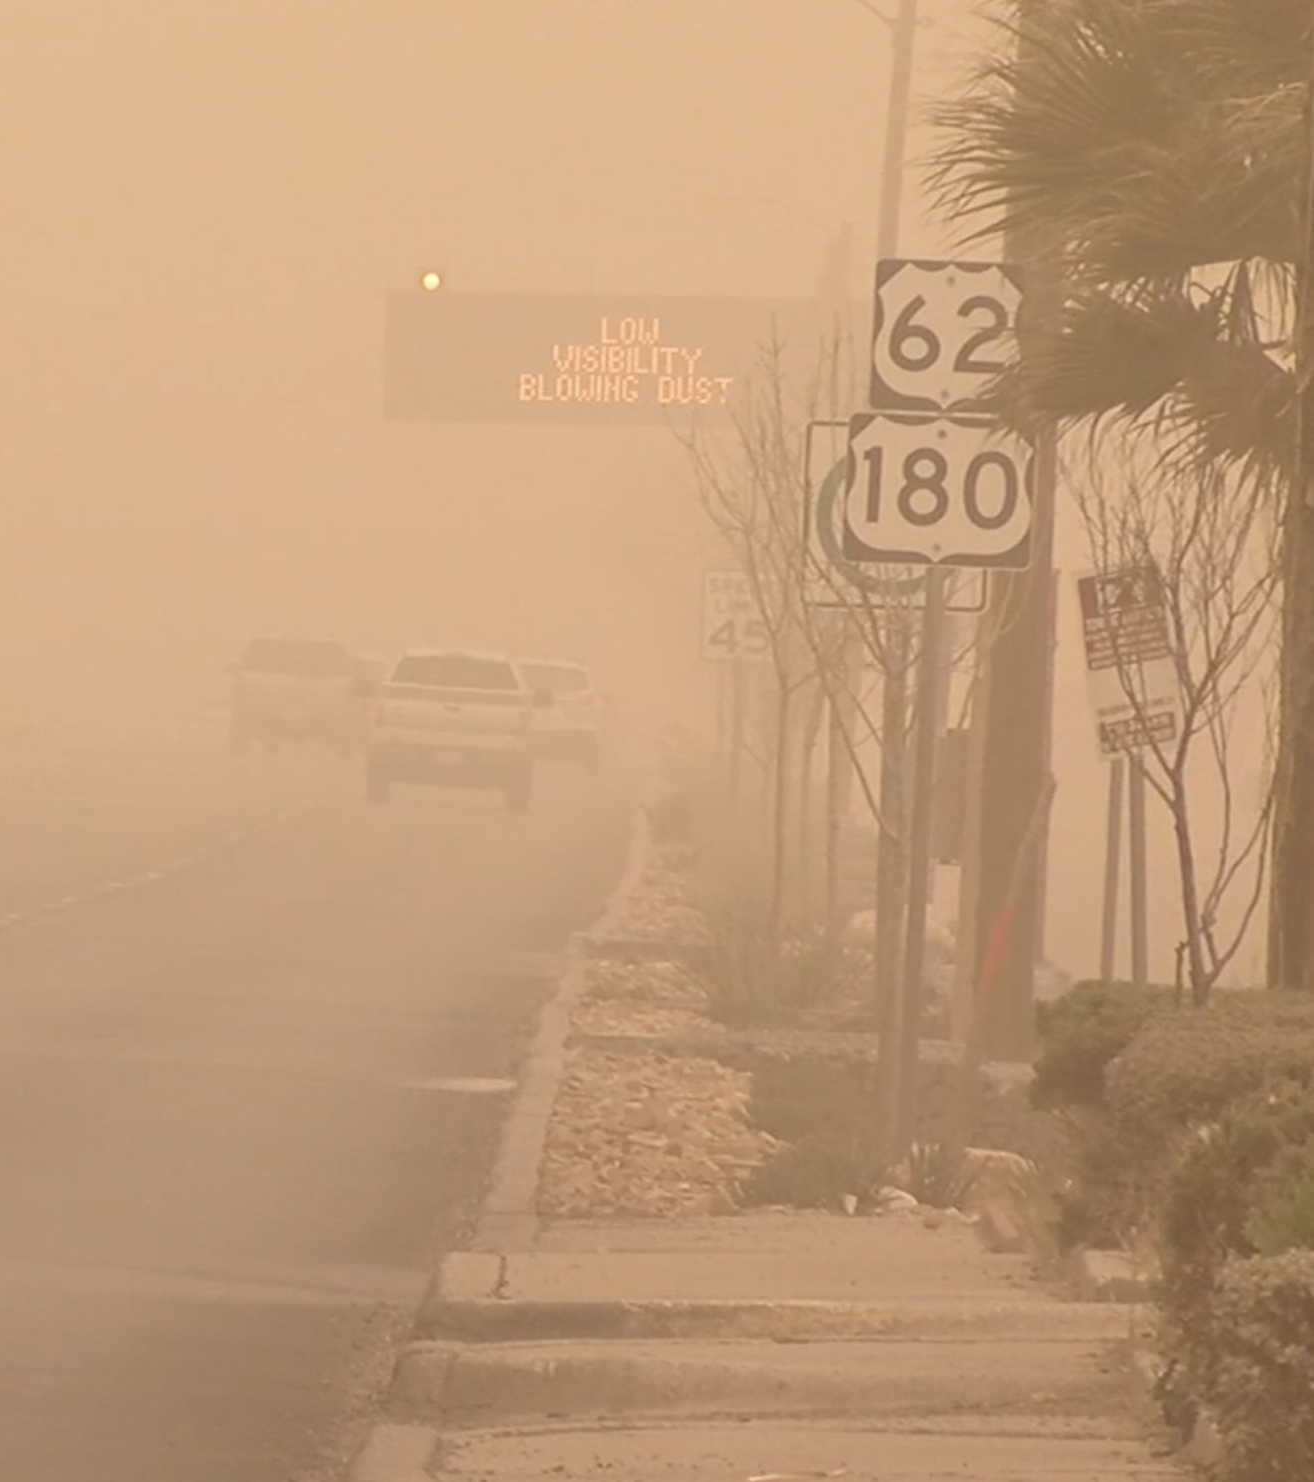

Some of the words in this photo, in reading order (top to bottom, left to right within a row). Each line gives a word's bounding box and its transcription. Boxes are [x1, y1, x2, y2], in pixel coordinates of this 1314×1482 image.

[601, 317, 660, 344] LOW
[888, 294, 1008, 373] 62
[552, 345, 702, 374] VISIBILITY
[518, 373, 639, 402] BLOWING
[657, 376, 734, 403] DUST
[862, 445, 1019, 530] 180
[708, 620, 769, 654] 45
